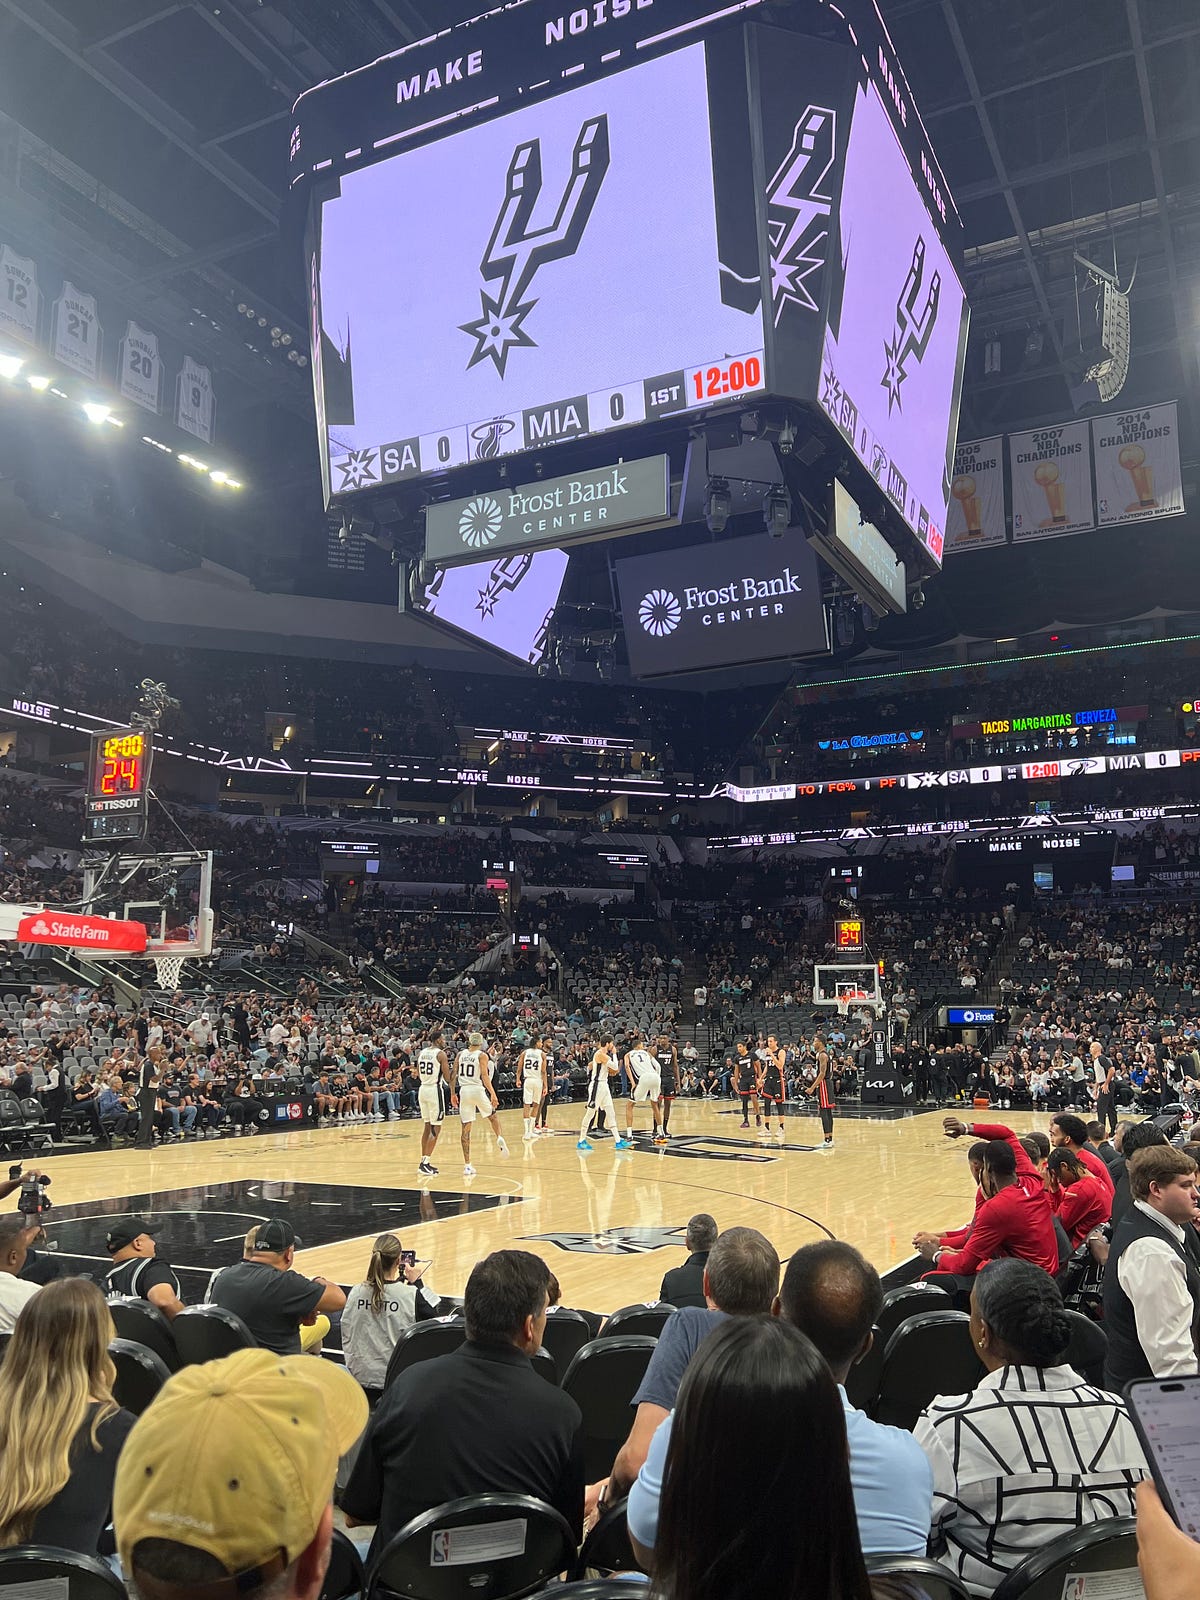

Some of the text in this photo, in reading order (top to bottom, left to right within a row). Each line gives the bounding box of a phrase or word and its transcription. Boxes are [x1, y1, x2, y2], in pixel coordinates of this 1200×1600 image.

[396, 49, 483, 103] MAKE
[878, 45, 946, 224] MAKE NOISE
[7, 278, 28, 309] 12
[67, 313, 88, 344] 21
[129, 350, 152, 379] 20
[192, 387, 201, 408] 9
[384, 357, 761, 474] SA 0 MIA 0 1ST 12:00
[1117, 411, 1151, 426] 2014
[1032, 429, 1064, 442] 2007
[1100, 426, 1170, 447] CHAMPIONS
[1122, 422, 1147, 434] NBA
[842, 399, 856, 438] SA
[861, 428, 867, 454] 0
[890, 467, 904, 507] MIA
[956, 444, 981, 456] 005
[1017, 443, 1082, 464] CHAMPIONS
[1037, 439, 1060, 451] NBA
[954, 459, 996, 475] MPIONS
[956, 455, 976, 466] NBA
[508, 470, 628, 519] Frost Bank
[522, 507, 609, 535] CENTER
[683, 568, 801, 610] Frost Bank
[702, 603, 785, 626] CENTER
[13, 699, 51, 718] NOISE
[982, 708, 1118, 734] TACOS MARGARITAS CERVEZA
[104, 735, 142, 758] 12:00
[503, 732, 607, 746] MAKE NOISE
[832, 732, 909, 750] LA GLORIA
[949, 771, 969, 783] SA
[982, 769, 989, 781] 0
[1025, 762, 1059, 777] 12:00
[1109, 755, 1141, 770] MIA
[1158, 753, 1166, 766] 0
[101, 760, 136, 794] 24
[457, 771, 541, 785] MAKE NOISE
[798, 785, 815, 795] TO
[828, 782, 857, 793] FG%
[879, 778, 897, 788] PF
[104, 798, 140, 810] TISSOT
[1095, 808, 1167, 820] MAKE NOISE
[907, 822, 970, 833] MAKE NOISE
[741, 834, 795, 844] MAKE NOISE
[989, 839, 1082, 852] MAKE NOISE
[841, 931, 859, 945] 24
[975, 1012, 995, 1021] Frost
[525, 1059, 539, 1070] 24
[638, 1054, 644, 1062] 1
[419, 1061, 433, 1075] 28
[460, 1063, 475, 1077] 10
